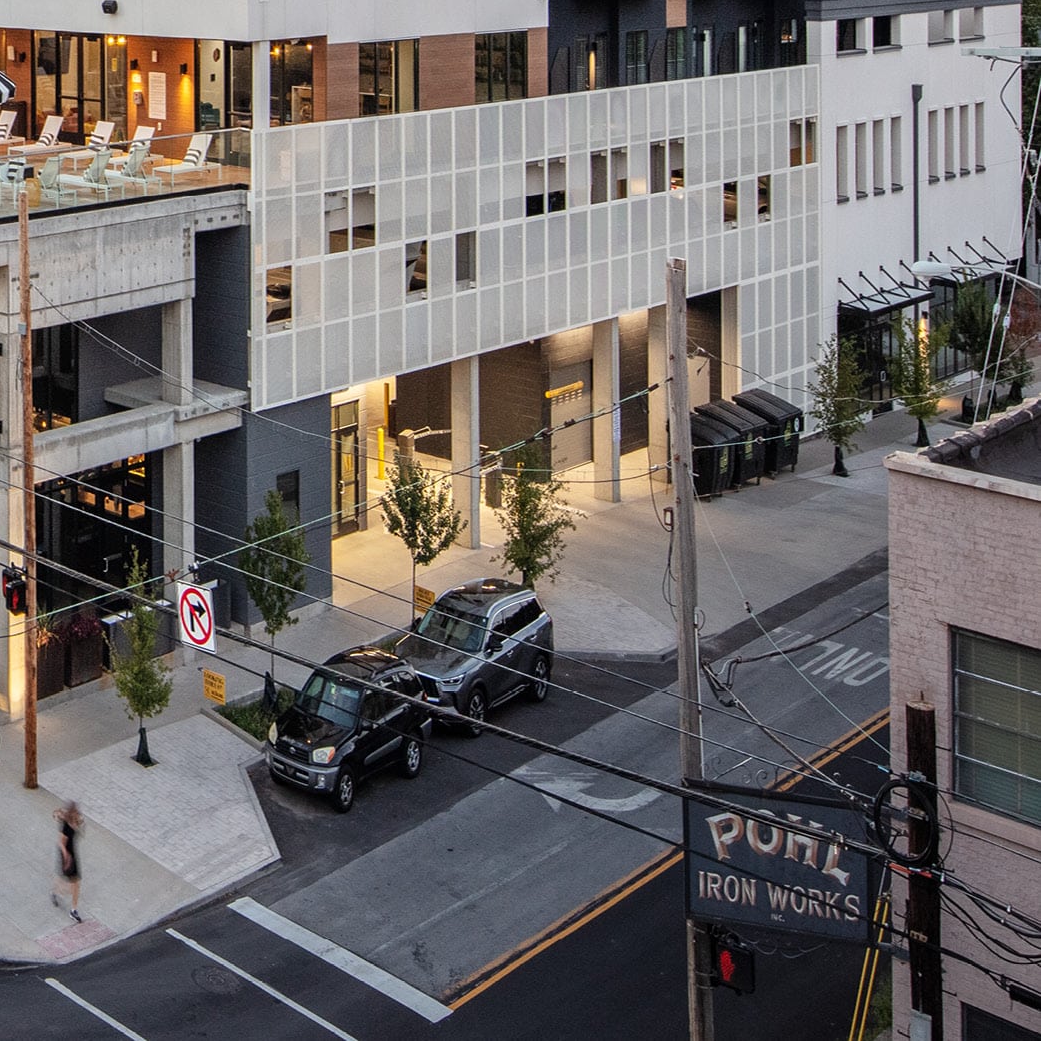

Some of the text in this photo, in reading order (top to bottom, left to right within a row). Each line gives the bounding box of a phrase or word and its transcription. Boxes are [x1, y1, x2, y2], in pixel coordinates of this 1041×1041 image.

[705, 809, 851, 887] POHL
[698, 870, 861, 923] IRON WORKS
